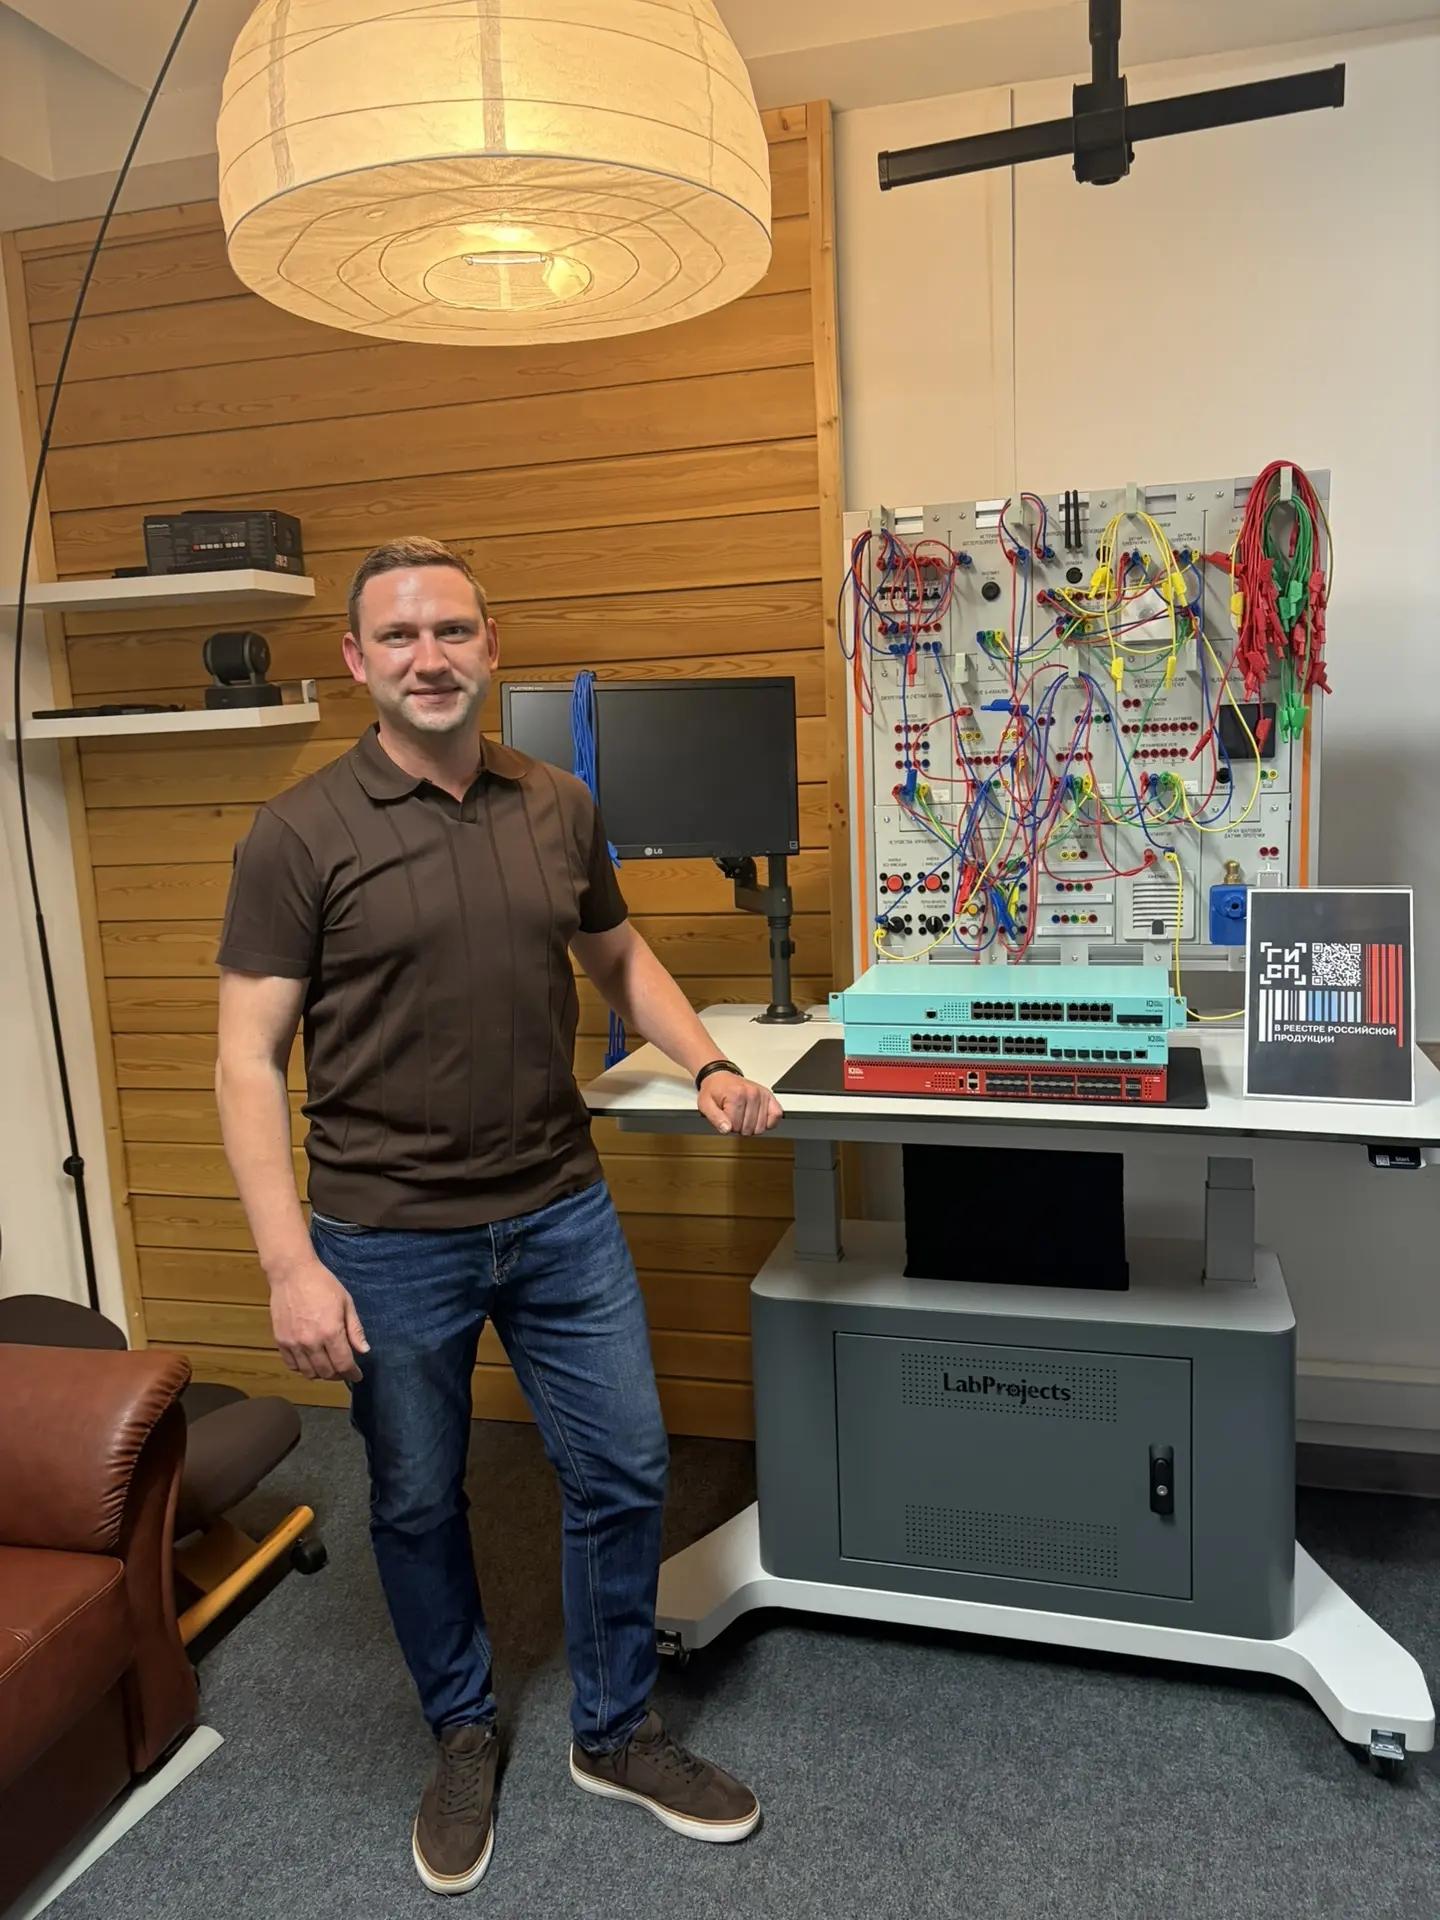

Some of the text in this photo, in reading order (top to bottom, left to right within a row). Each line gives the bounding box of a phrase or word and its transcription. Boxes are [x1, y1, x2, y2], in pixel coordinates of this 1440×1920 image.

[1267, 948, 1299, 963] ГИ
[1274, 1024, 1397, 1036] В РЕЕСТРЕ РОССИЙСКОЙ
[1274, 1034, 1335, 1044] ПРОДУКЦИИ
[942, 1372, 1072, 1405] LabProjects
